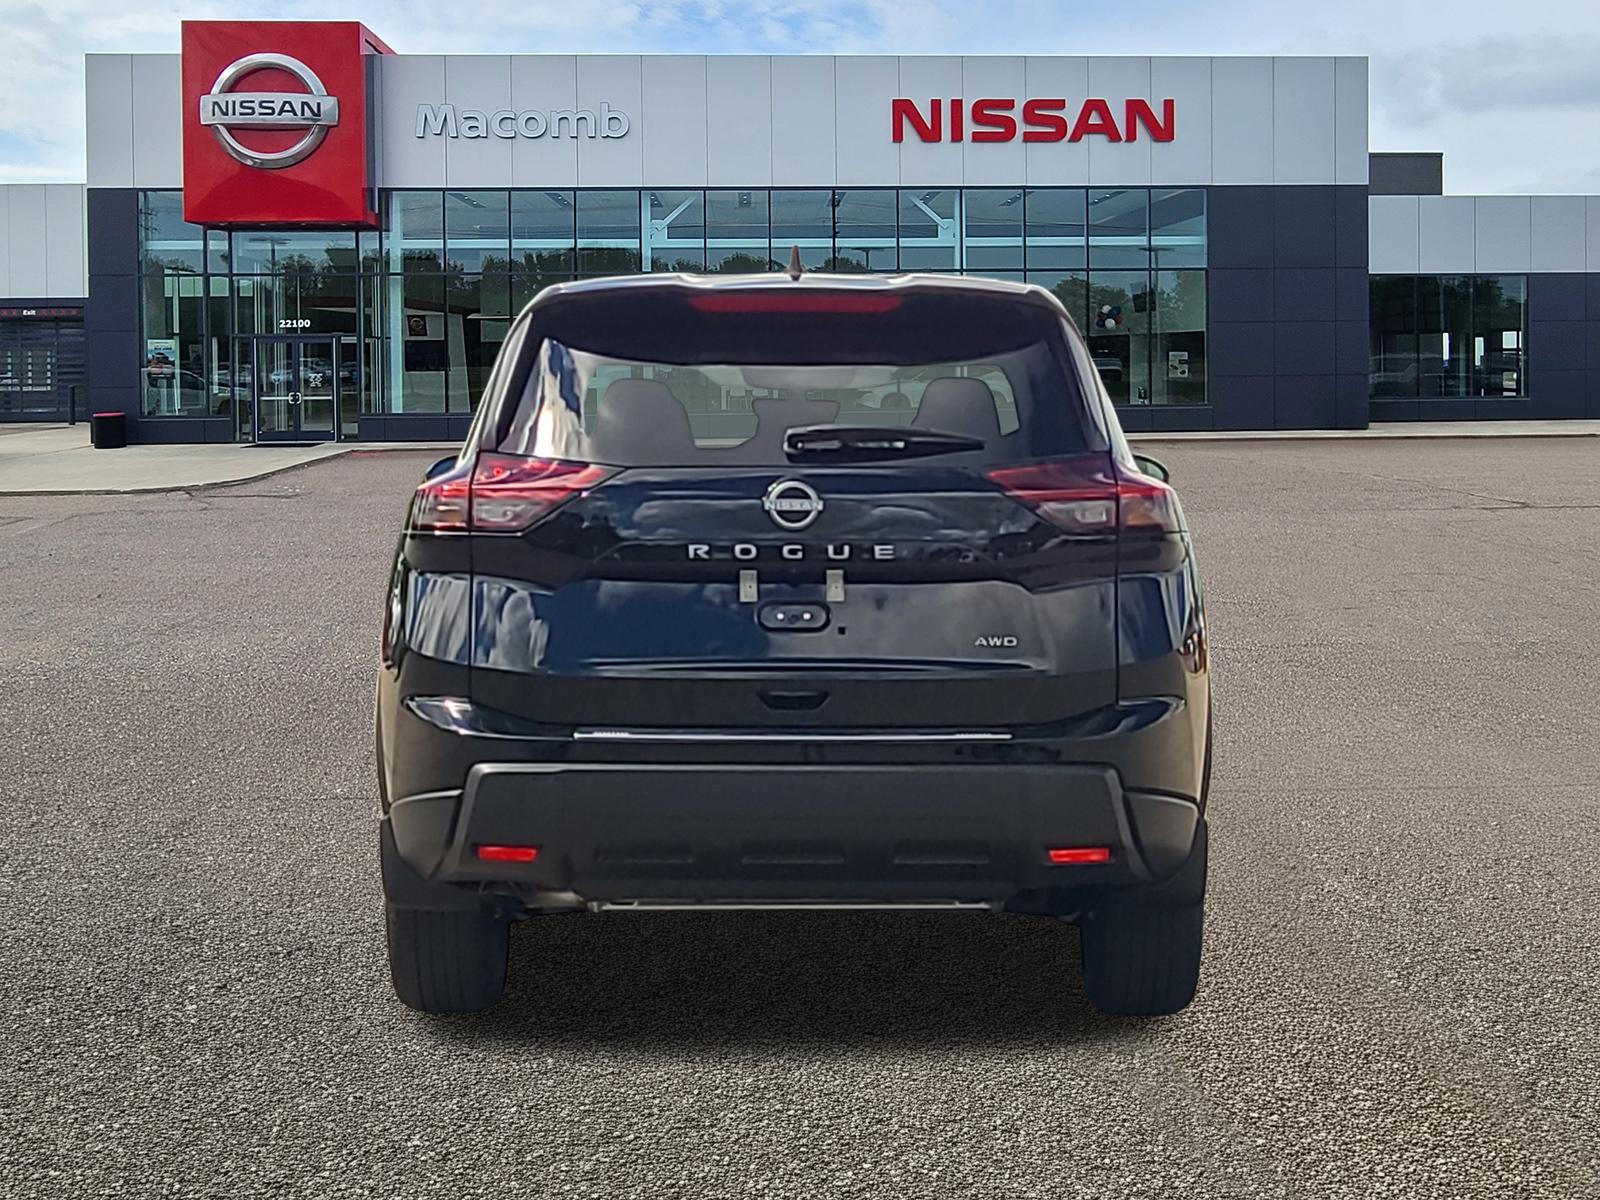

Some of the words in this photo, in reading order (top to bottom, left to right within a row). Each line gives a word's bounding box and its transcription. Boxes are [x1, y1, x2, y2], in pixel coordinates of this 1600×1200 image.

[212, 100, 321, 117] NISSAN
[415, 102, 630, 139] Macomb
[892, 98, 1175, 143] NISSAN
[279, 319, 311, 328] 22100
[688, 544, 895, 560] ROGUE
[974, 636, 1018, 646] AWD
